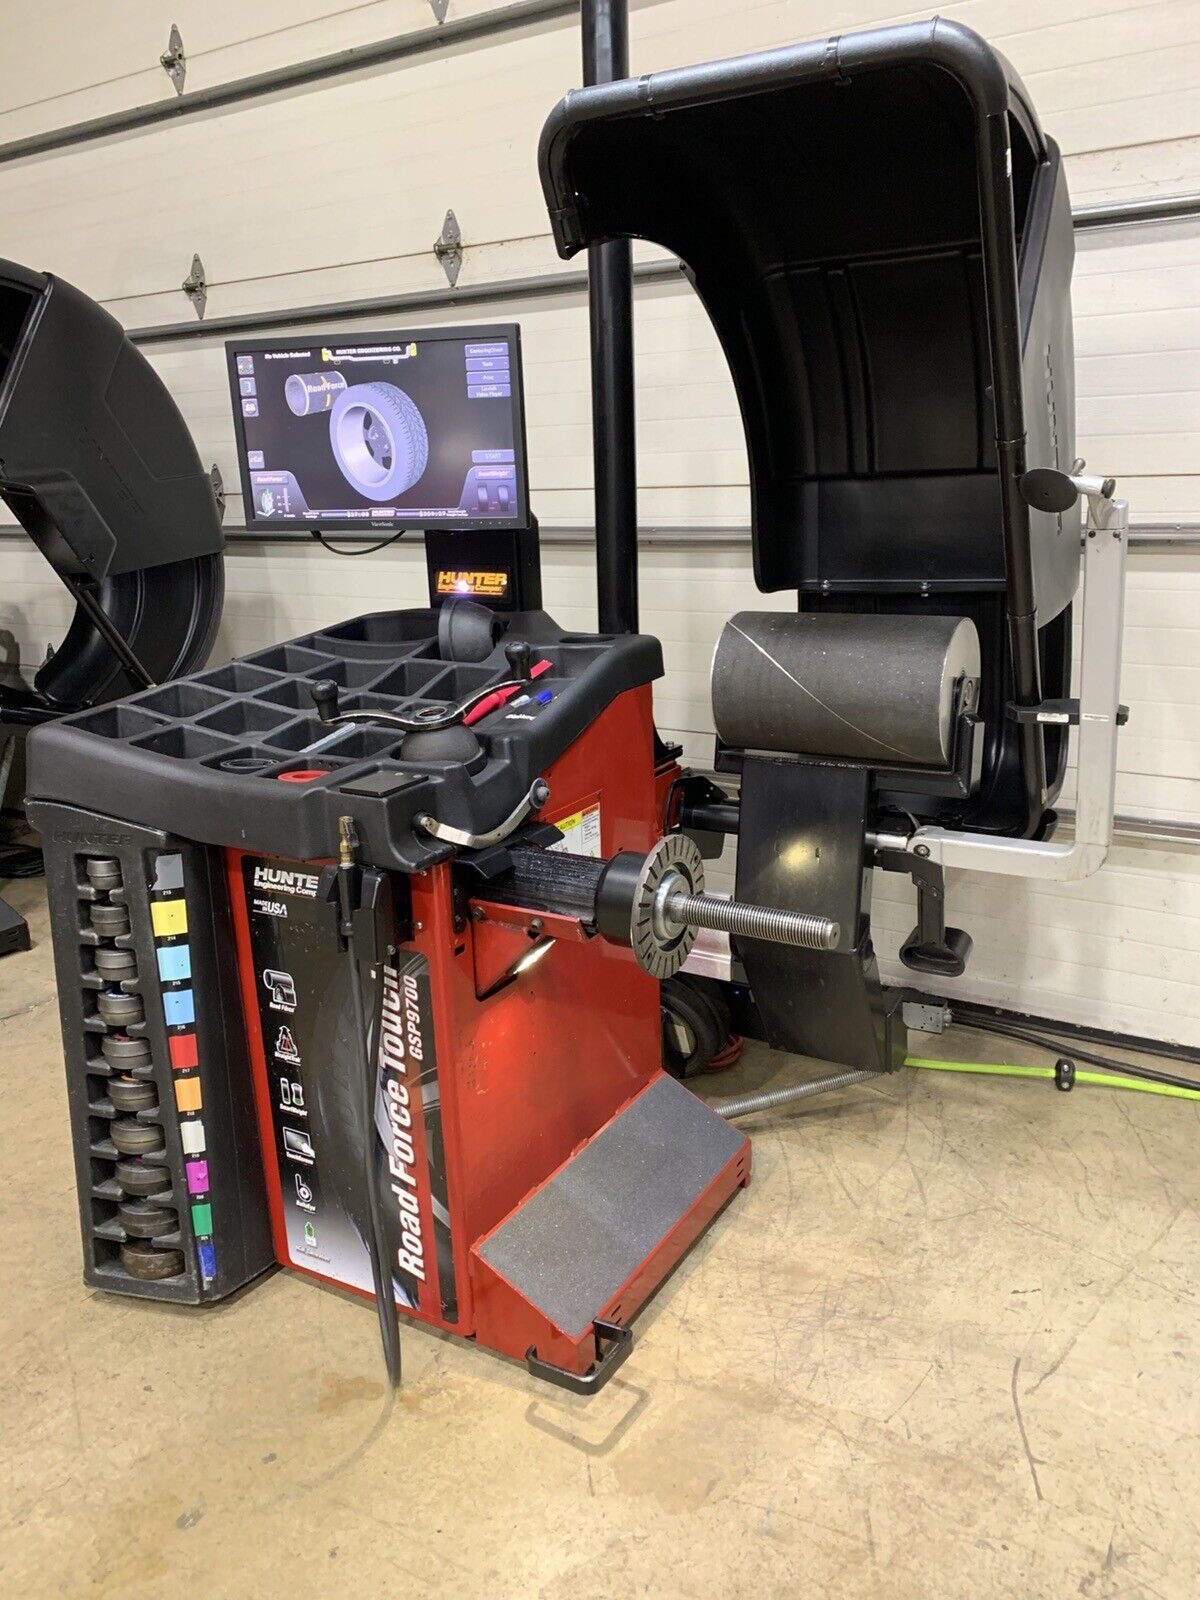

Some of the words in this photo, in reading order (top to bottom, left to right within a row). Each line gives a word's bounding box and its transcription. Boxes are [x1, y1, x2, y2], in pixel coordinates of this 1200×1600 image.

[437, 571, 507, 586] HUNTER
[253, 866, 319, 889] HUNTE
[253, 879, 296, 894] Engineering
[296, 886, 317, 897] Comp
[268, 902, 287, 915] USA
[403, 974, 424, 1061] GSP9700
[387, 1079, 417, 1187] Force
[391, 1183, 426, 1281] Road
